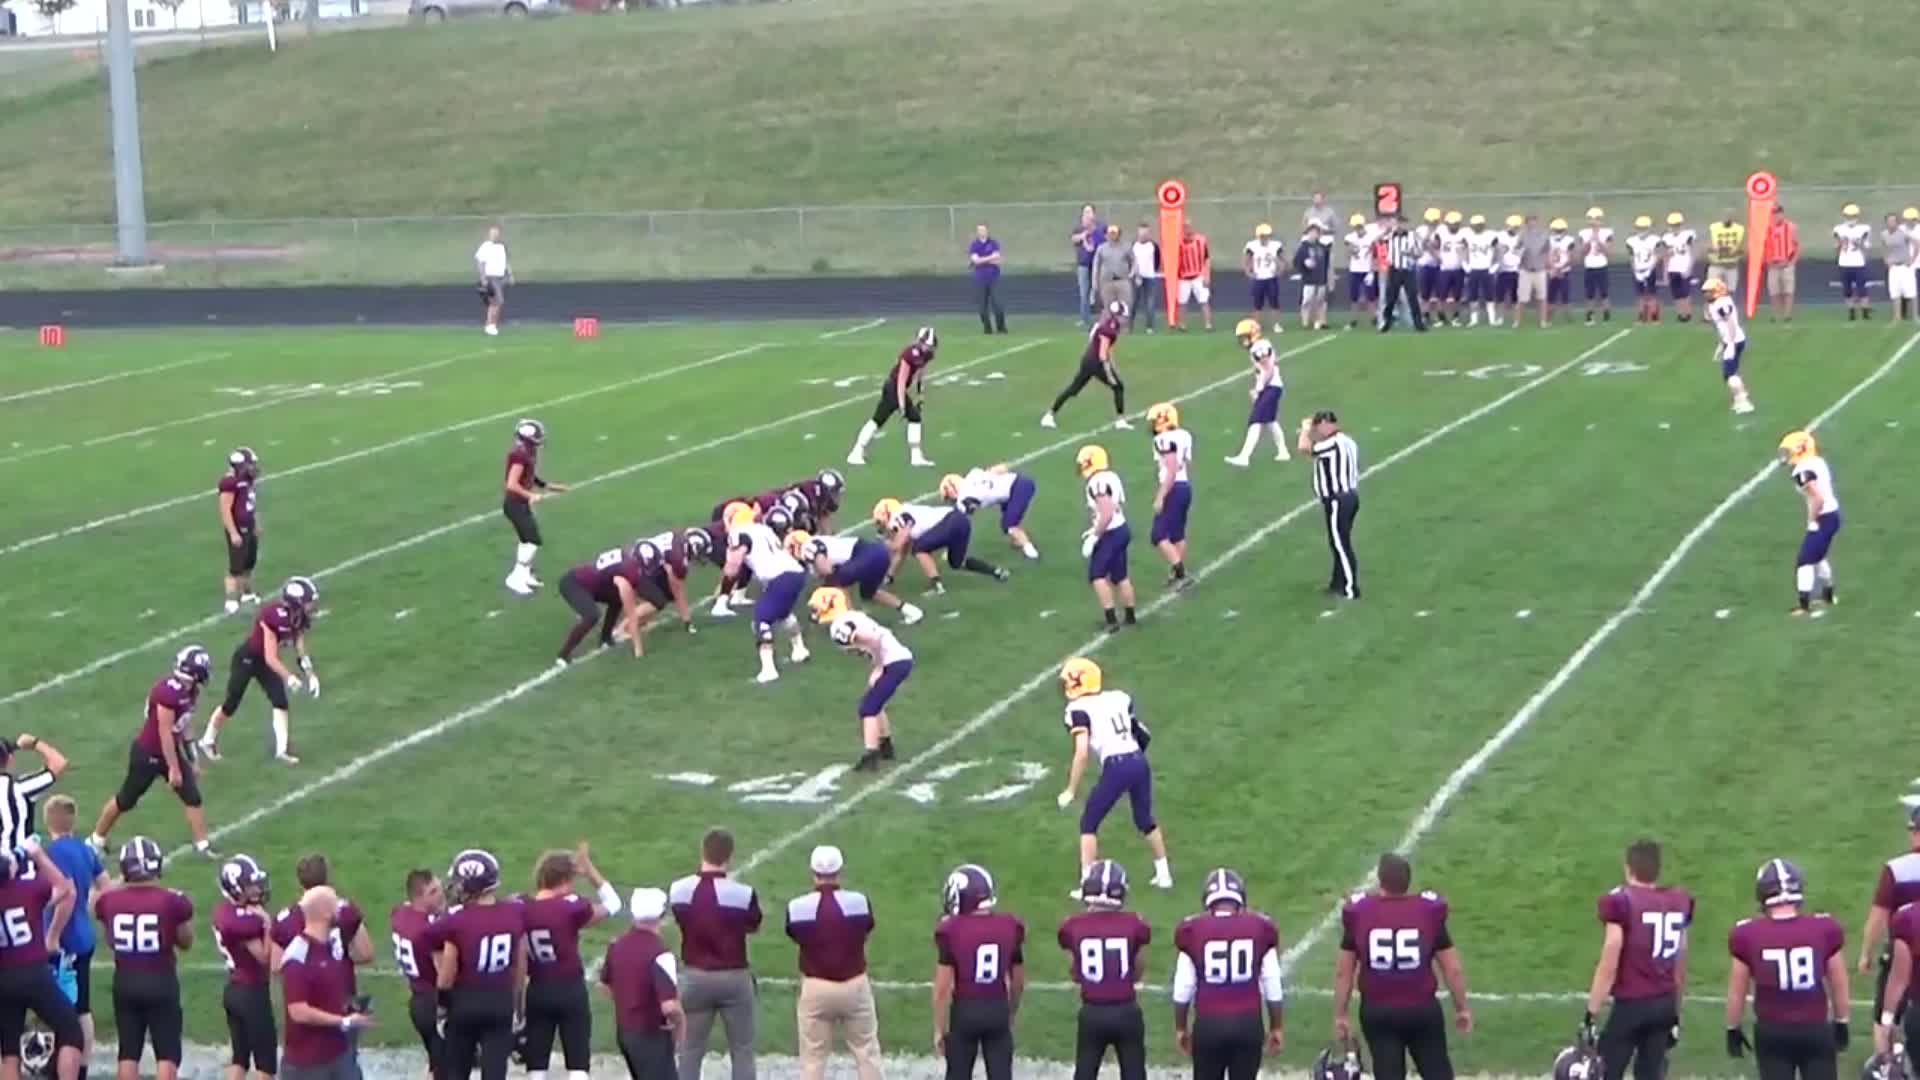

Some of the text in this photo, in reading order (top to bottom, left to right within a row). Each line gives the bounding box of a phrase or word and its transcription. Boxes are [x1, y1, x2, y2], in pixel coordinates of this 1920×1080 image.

[1378, 185, 1398, 213] 2
[1110, 711, 1129, 741] 4
[113, 913, 160, 952] 56
[1369, 928, 1421, 969] 65
[1642, 912, 1684, 959] 75
[477, 933, 512, 973] 18
[975, 944, 999, 983] 8
[1080, 937, 1129, 982] 87
[1204, 939, 1255, 983] 60
[1762, 946, 1815, 990] 78
